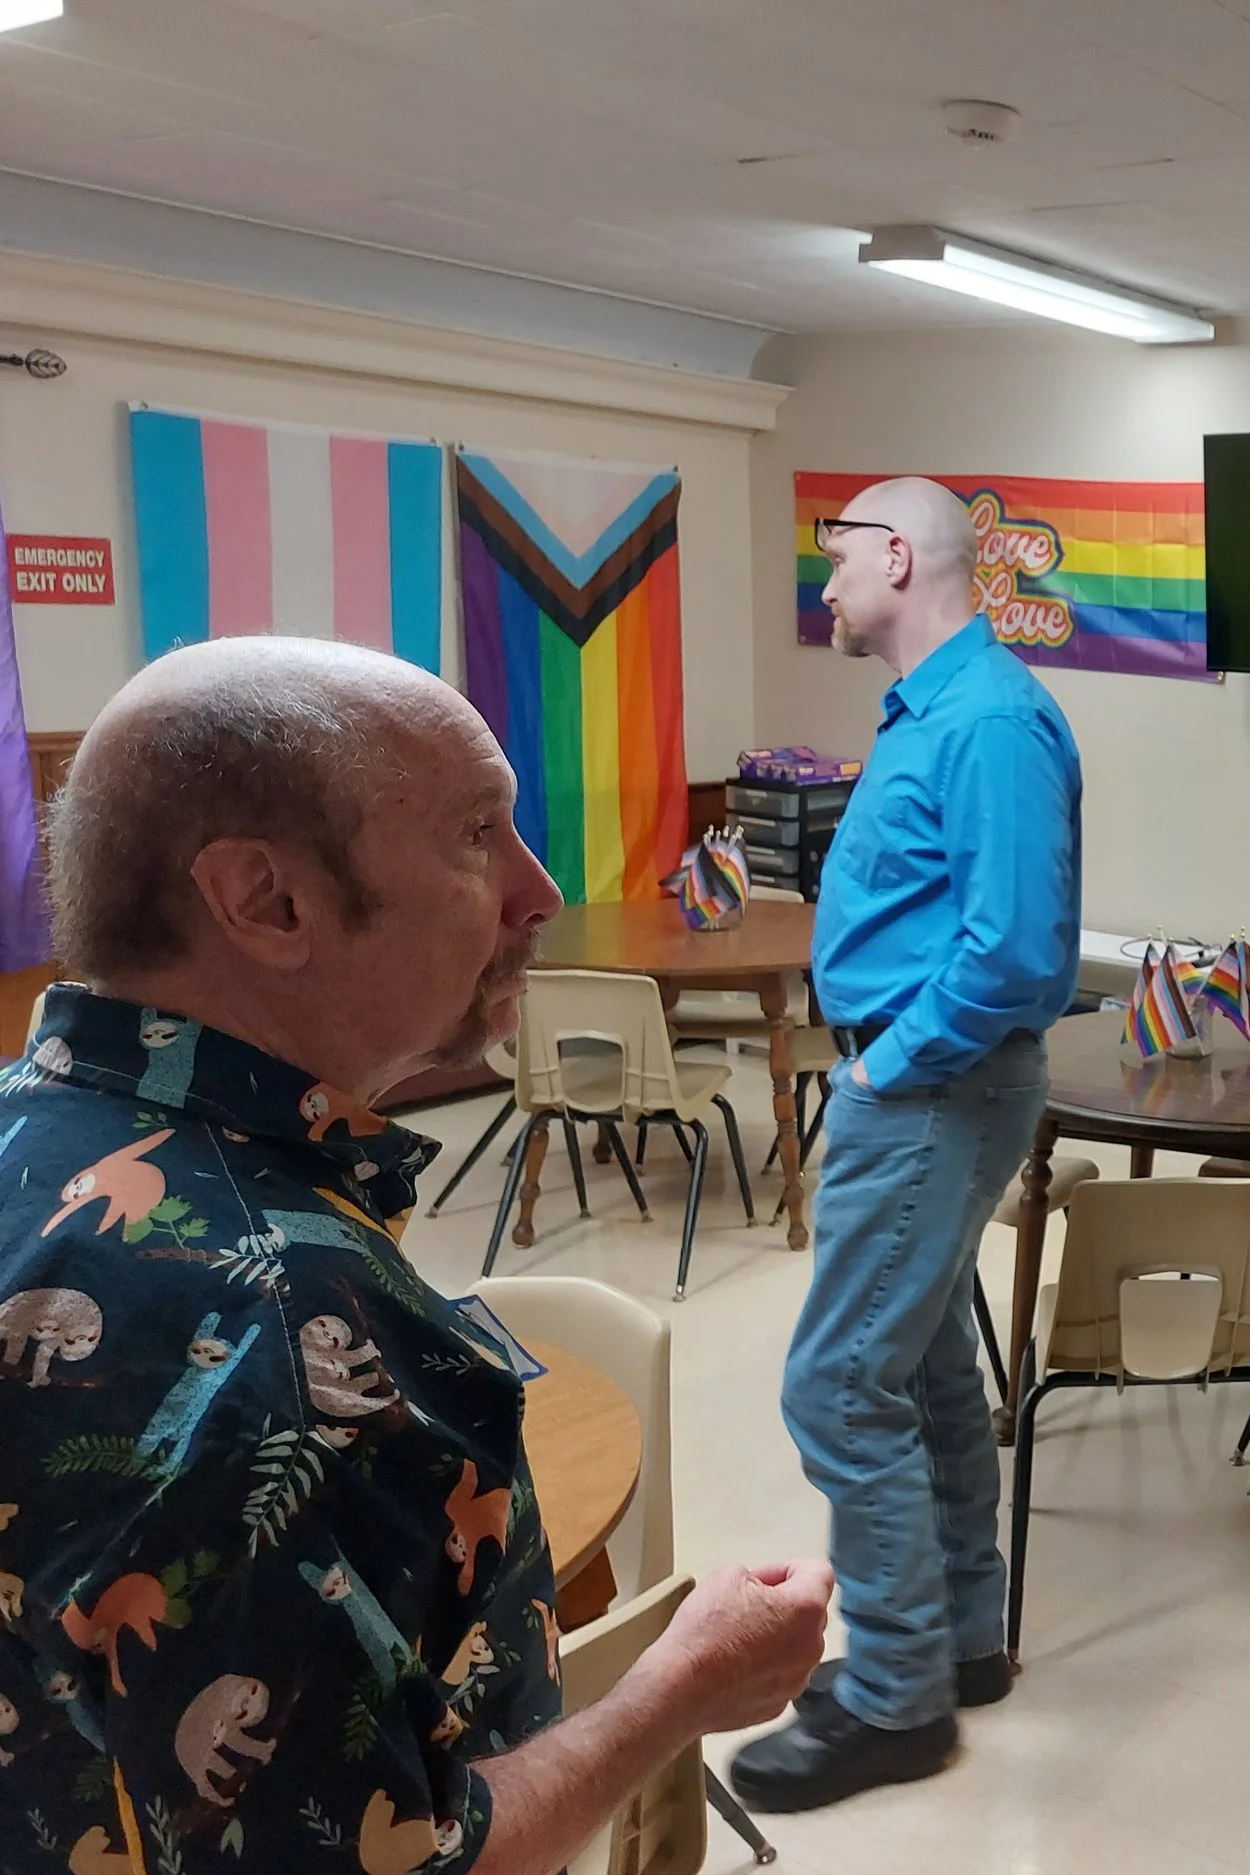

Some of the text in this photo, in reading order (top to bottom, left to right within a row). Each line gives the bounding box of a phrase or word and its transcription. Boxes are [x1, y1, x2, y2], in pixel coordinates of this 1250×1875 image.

[14, 547, 104, 568] EMERGENCY
[16, 571, 106, 593] EXIT ONLY
